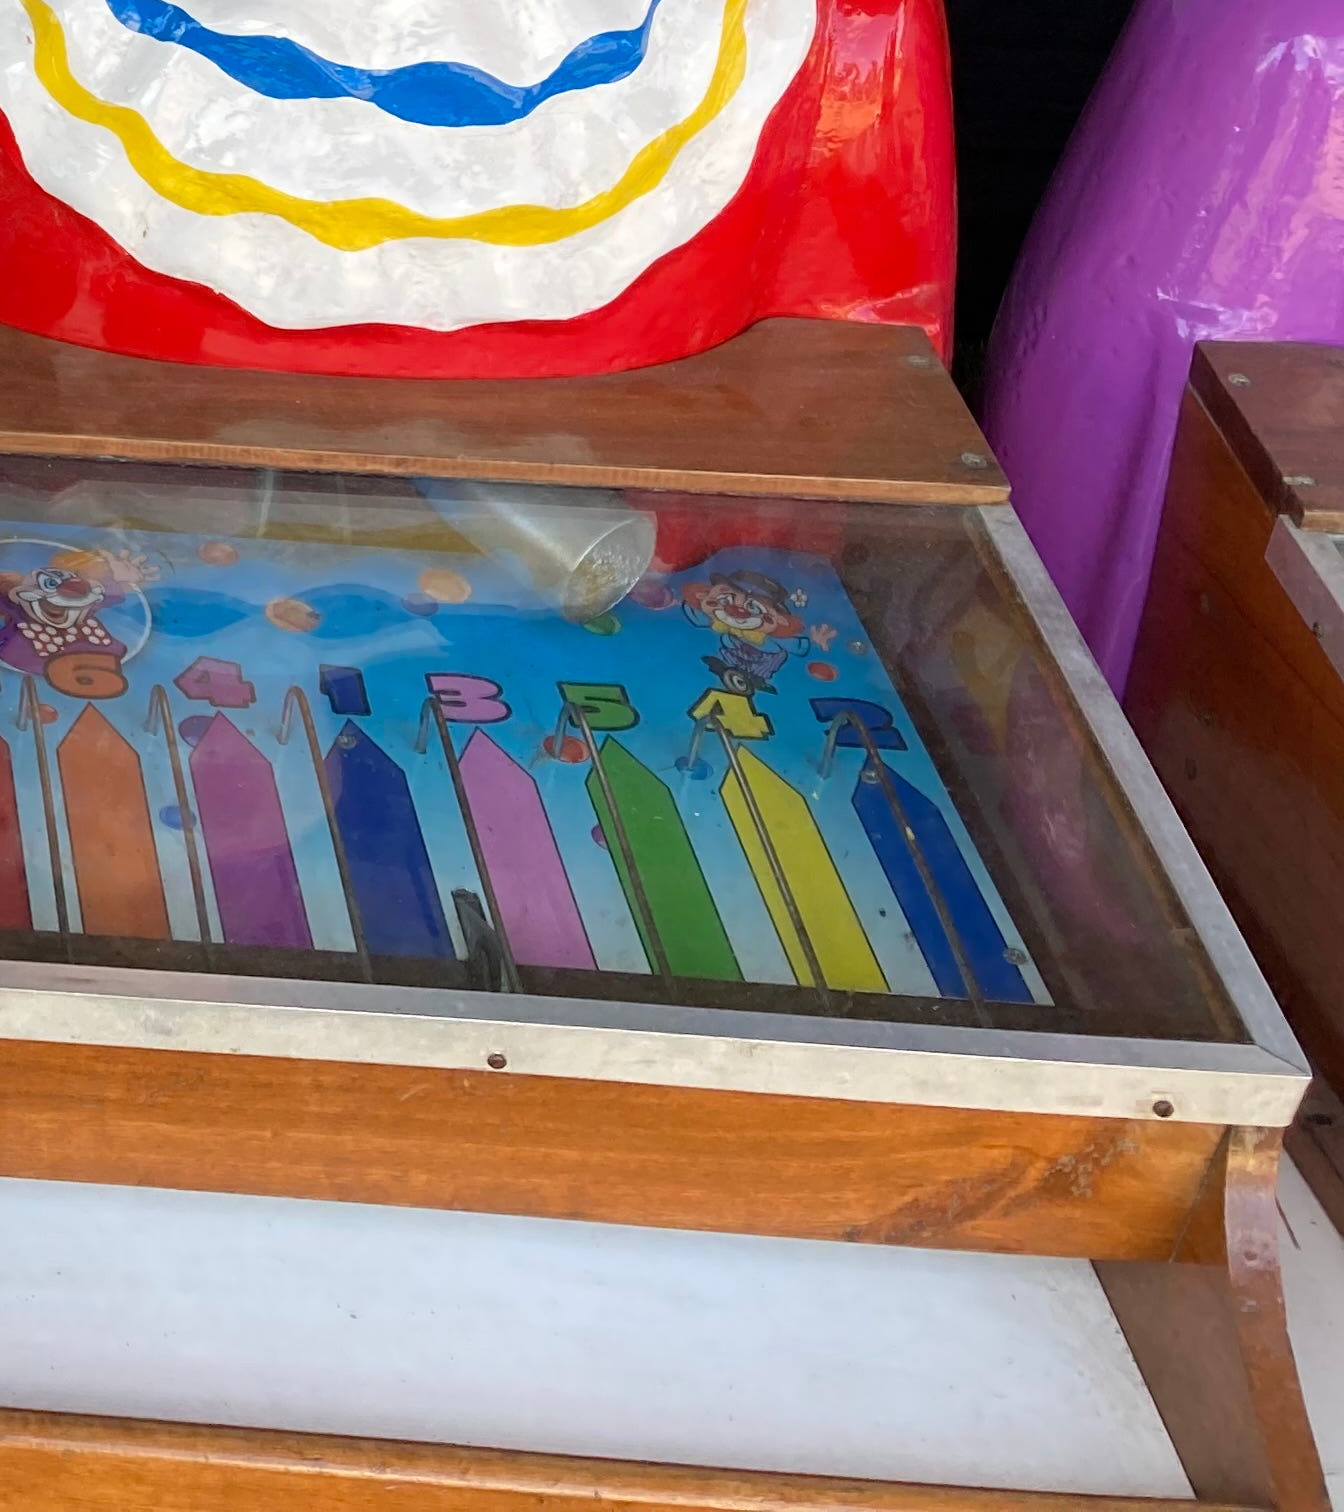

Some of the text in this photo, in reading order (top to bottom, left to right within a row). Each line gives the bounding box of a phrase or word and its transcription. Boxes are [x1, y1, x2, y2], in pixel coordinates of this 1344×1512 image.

[42, 651, 129, 700] 6
[172, 655, 257, 709] 4
[318, 663, 372, 716] 1
[424, 672, 512, 724] 3
[556, 681, 640, 731] 5
[688, 687, 776, 741] 4
[810, 697, 909, 751] 2
